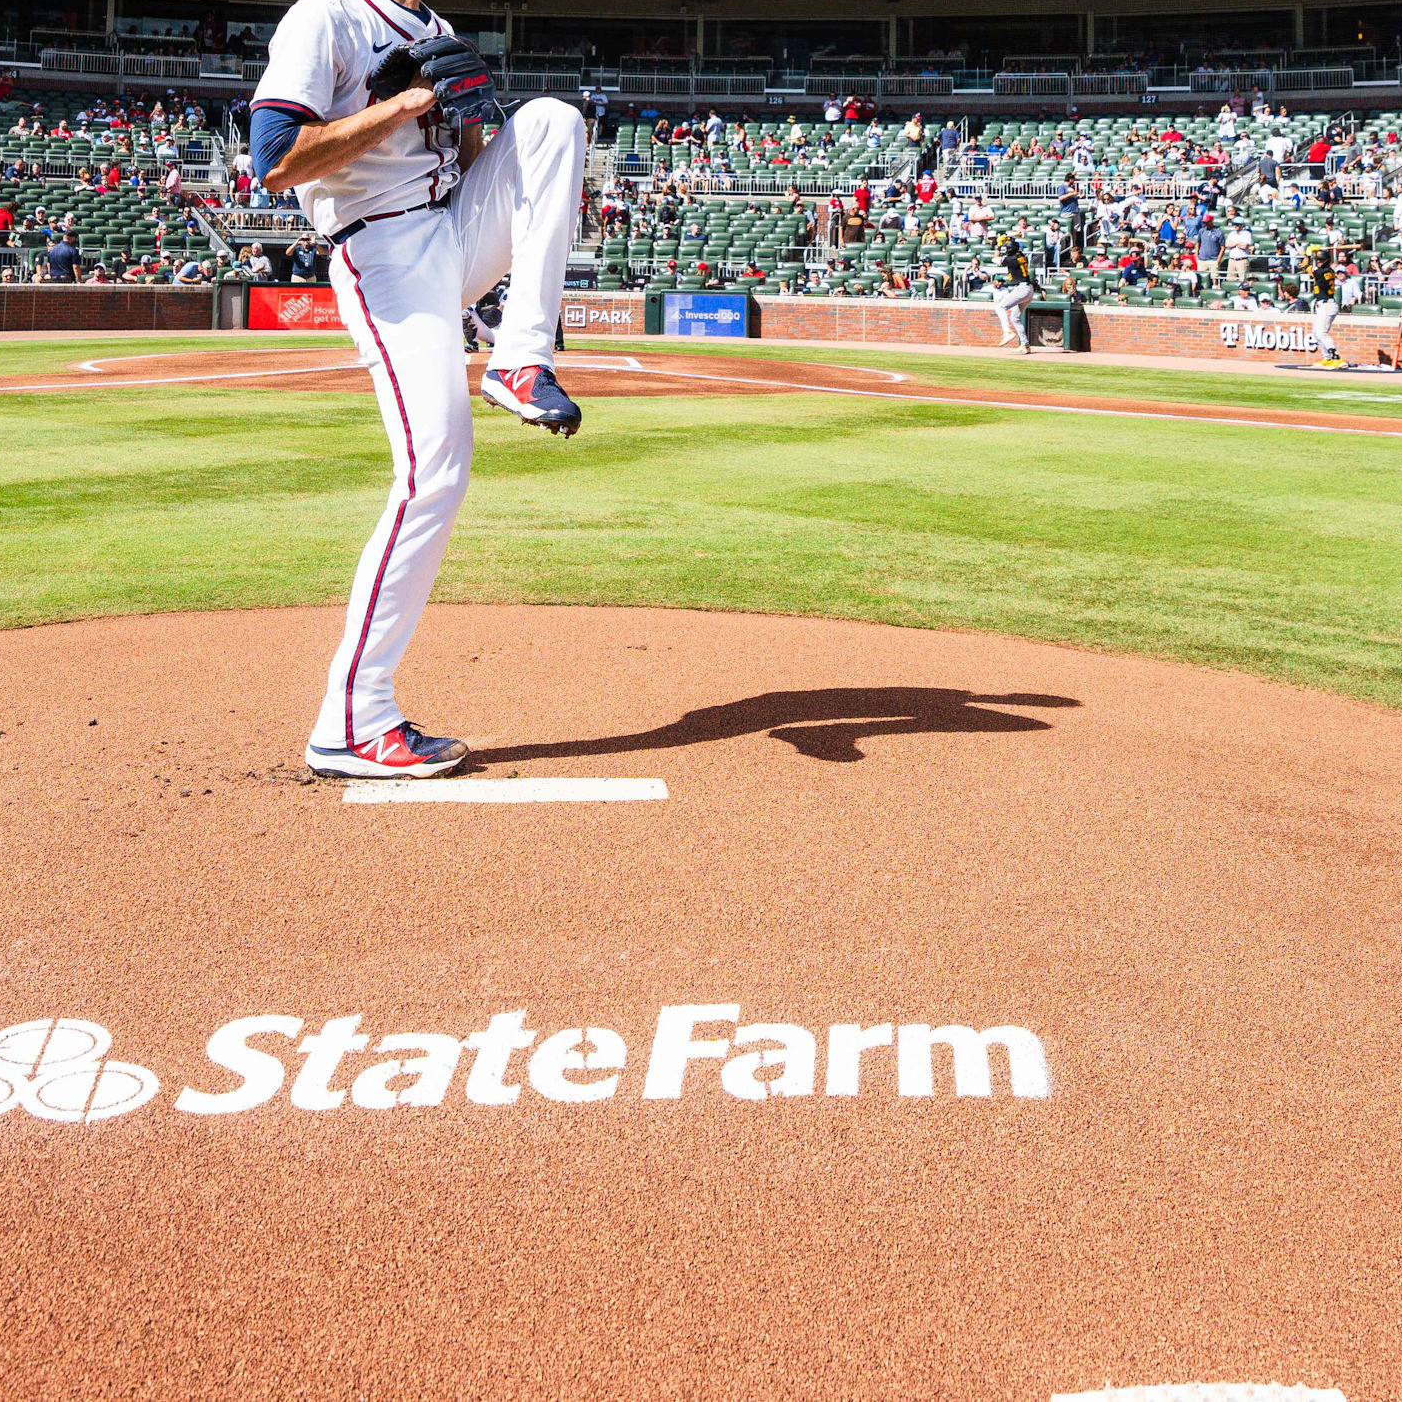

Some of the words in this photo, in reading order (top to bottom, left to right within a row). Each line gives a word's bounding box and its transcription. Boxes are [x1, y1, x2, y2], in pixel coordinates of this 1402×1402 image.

[1142, 95, 1156, 103] 127
[279, 294, 311, 322] HOME
[283, 297, 296, 309] THE
[590, 310, 633, 324] PARK
[685, 311, 719, 320] Invesco
[1243, 324, 1318, 351] Mobile
